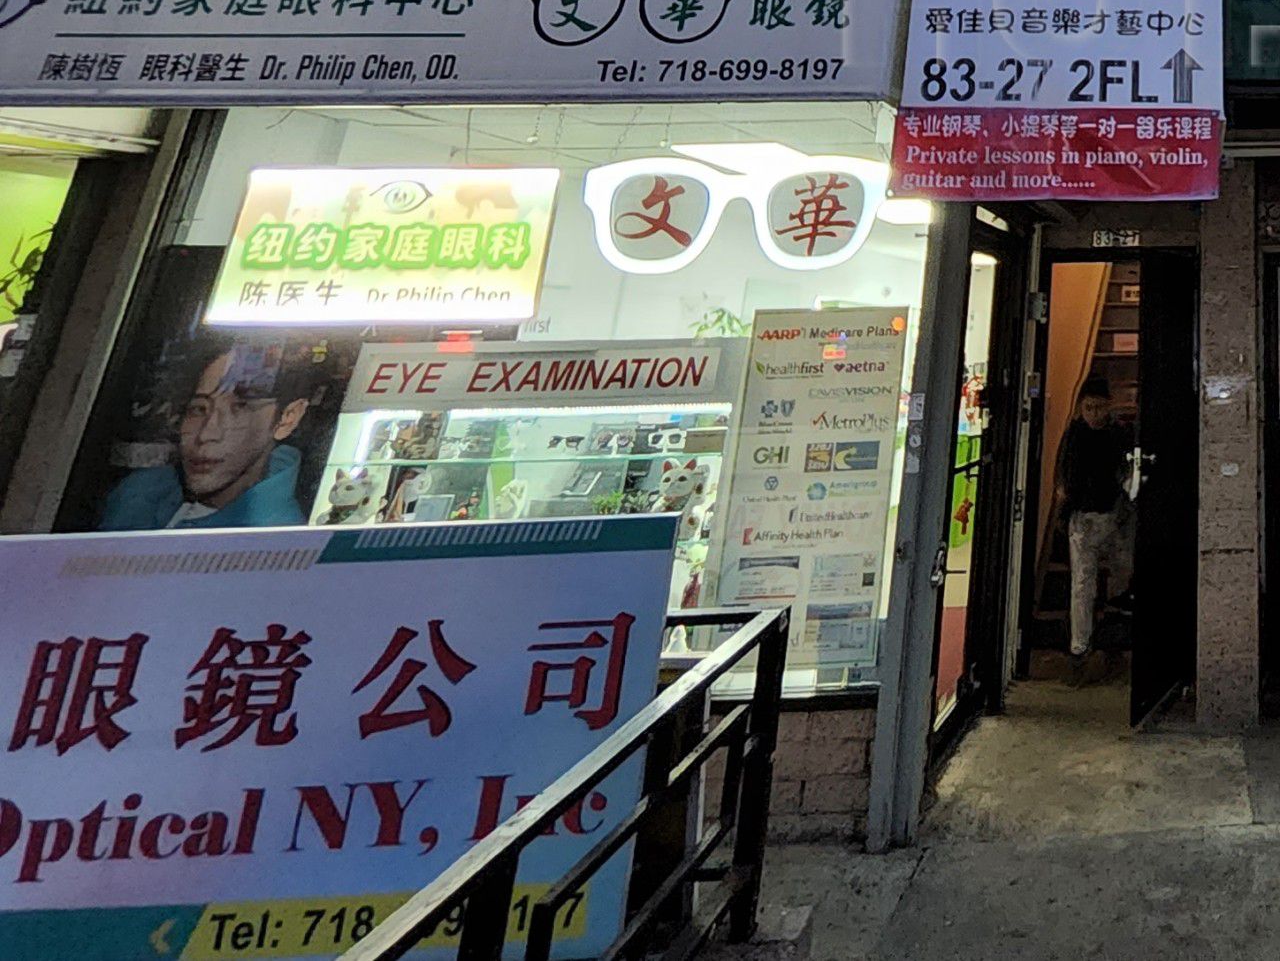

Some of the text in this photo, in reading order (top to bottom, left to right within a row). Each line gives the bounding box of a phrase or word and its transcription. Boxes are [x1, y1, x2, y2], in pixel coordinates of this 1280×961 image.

[139, 53, 250, 83] 眼科醫生
[259, 54, 288, 81] Dr.
[295, 54, 356, 86] Philip
[361, 54, 417, 84] Chen,
[425, 55, 459, 81] OD.
[597, 58, 845, 83] Tel: 718-699-8197
[920, 57, 1159, 104] 83-27 2FL
[906, 145, 1208, 168] Private lessons in piano, violin,
[902, 171, 963, 189] guitar
[970, 171, 1006, 188] and
[245, 226, 525, 264] 纽约家庭眼科
[758, 329, 801, 340] AARP
[366, 356, 709, 394] EYE EXAMINATION
[845, 361, 886, 374] aetna
[753, 445, 790, 465] GHI
[8, 612, 635, 755] 眼鏡公司
[287, 778, 440, 855] NY,
[463, 773, 608, 841] Ic
[209, 913, 283, 950] Tel:
